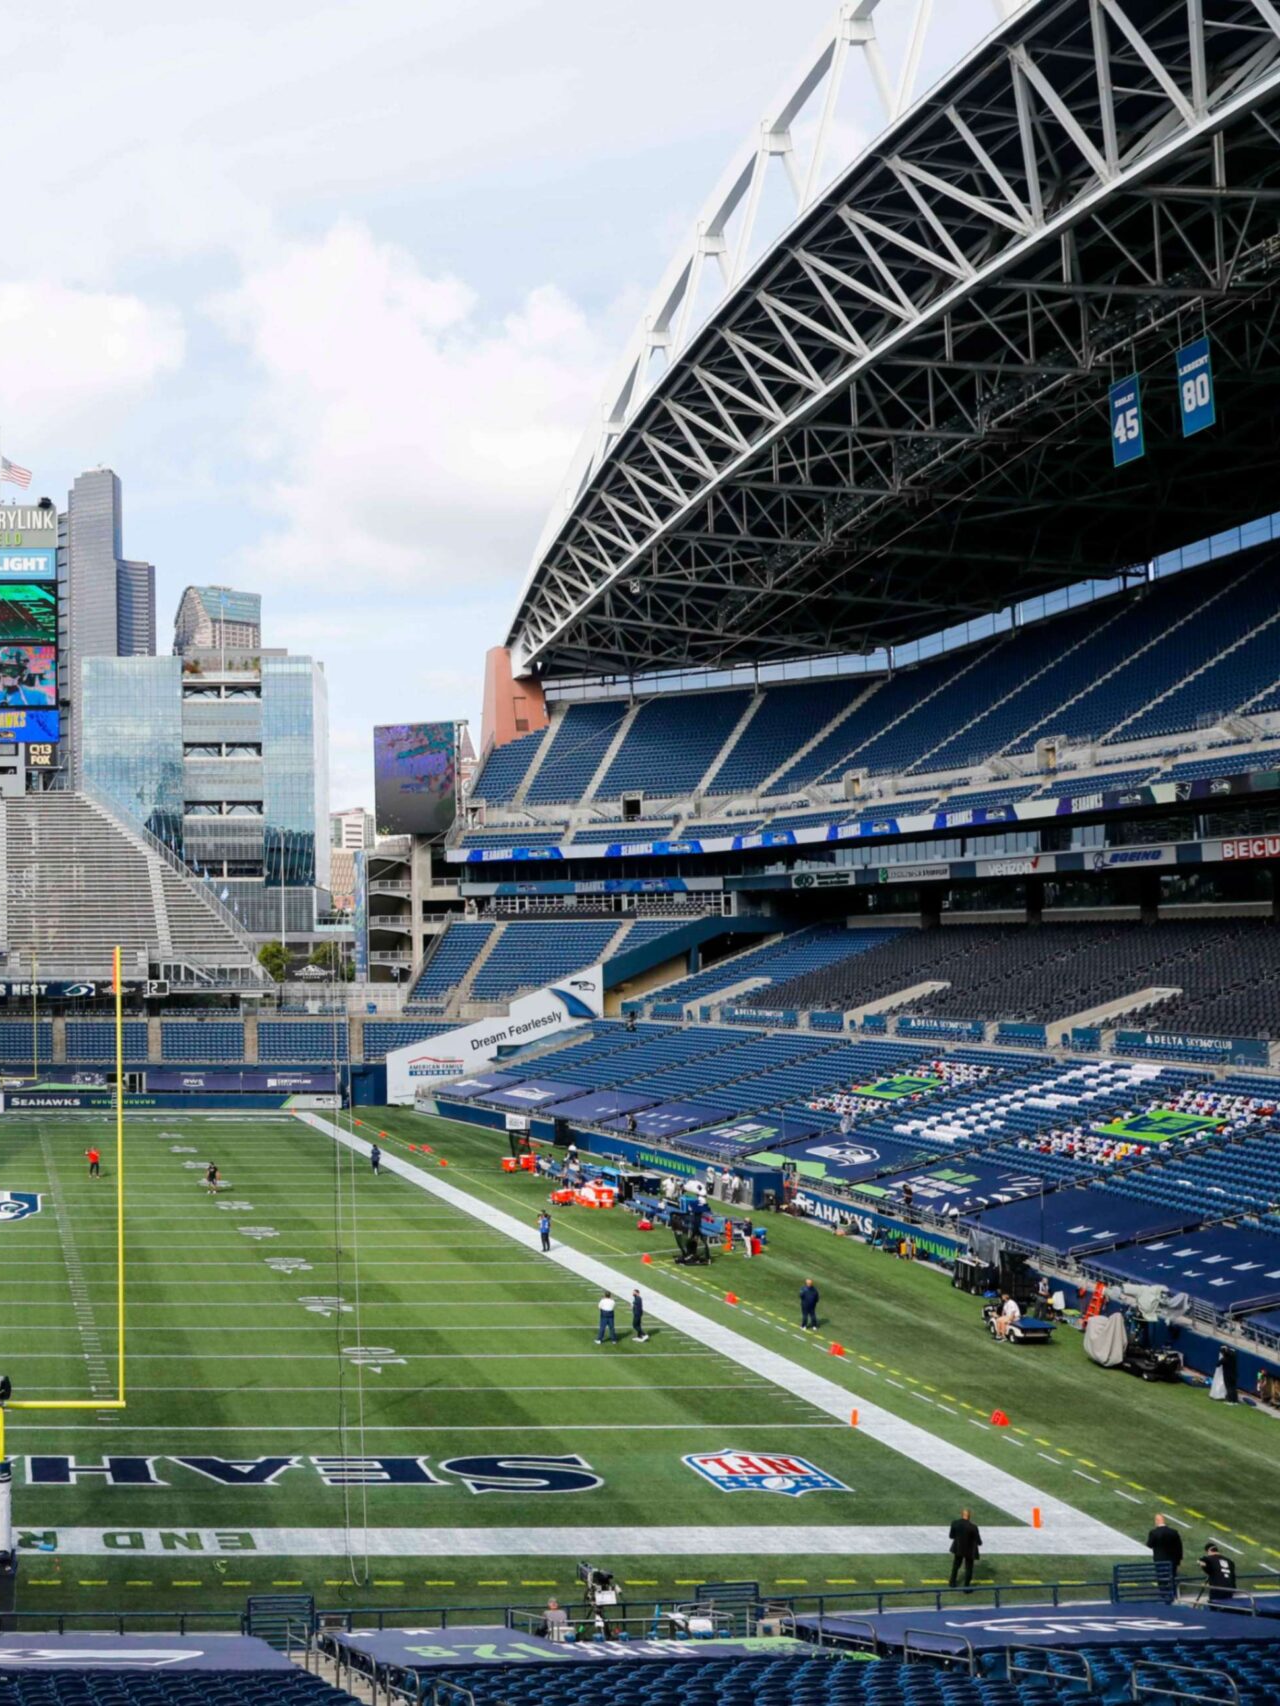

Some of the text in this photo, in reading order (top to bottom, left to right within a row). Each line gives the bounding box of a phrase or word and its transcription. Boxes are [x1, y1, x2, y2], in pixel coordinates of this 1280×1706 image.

[1183, 372, 1210, 413] 80
[1114, 407, 1139, 444] 45
[29, 744, 52, 755] Q13
[30, 755, 52, 765] FOX
[1109, 849, 1162, 863] BOEING
[1223, 838, 1280, 858] BECU
[988, 860, 1033, 876] verizon
[12, 984, 48, 996] NEST
[470, 1010, 562, 1051] Dream Fearlessly
[917, 1019, 938, 1027] DELTA
[1154, 1035, 1183, 1045] DELTA
[11, 1097, 81, 1106] SEAHAWKS
[297, 1295, 355, 1312] 20
[342, 1346, 408, 1365] 10
[699, 1456, 811, 1477] NFL
[104, 1531, 258, 1550] END
